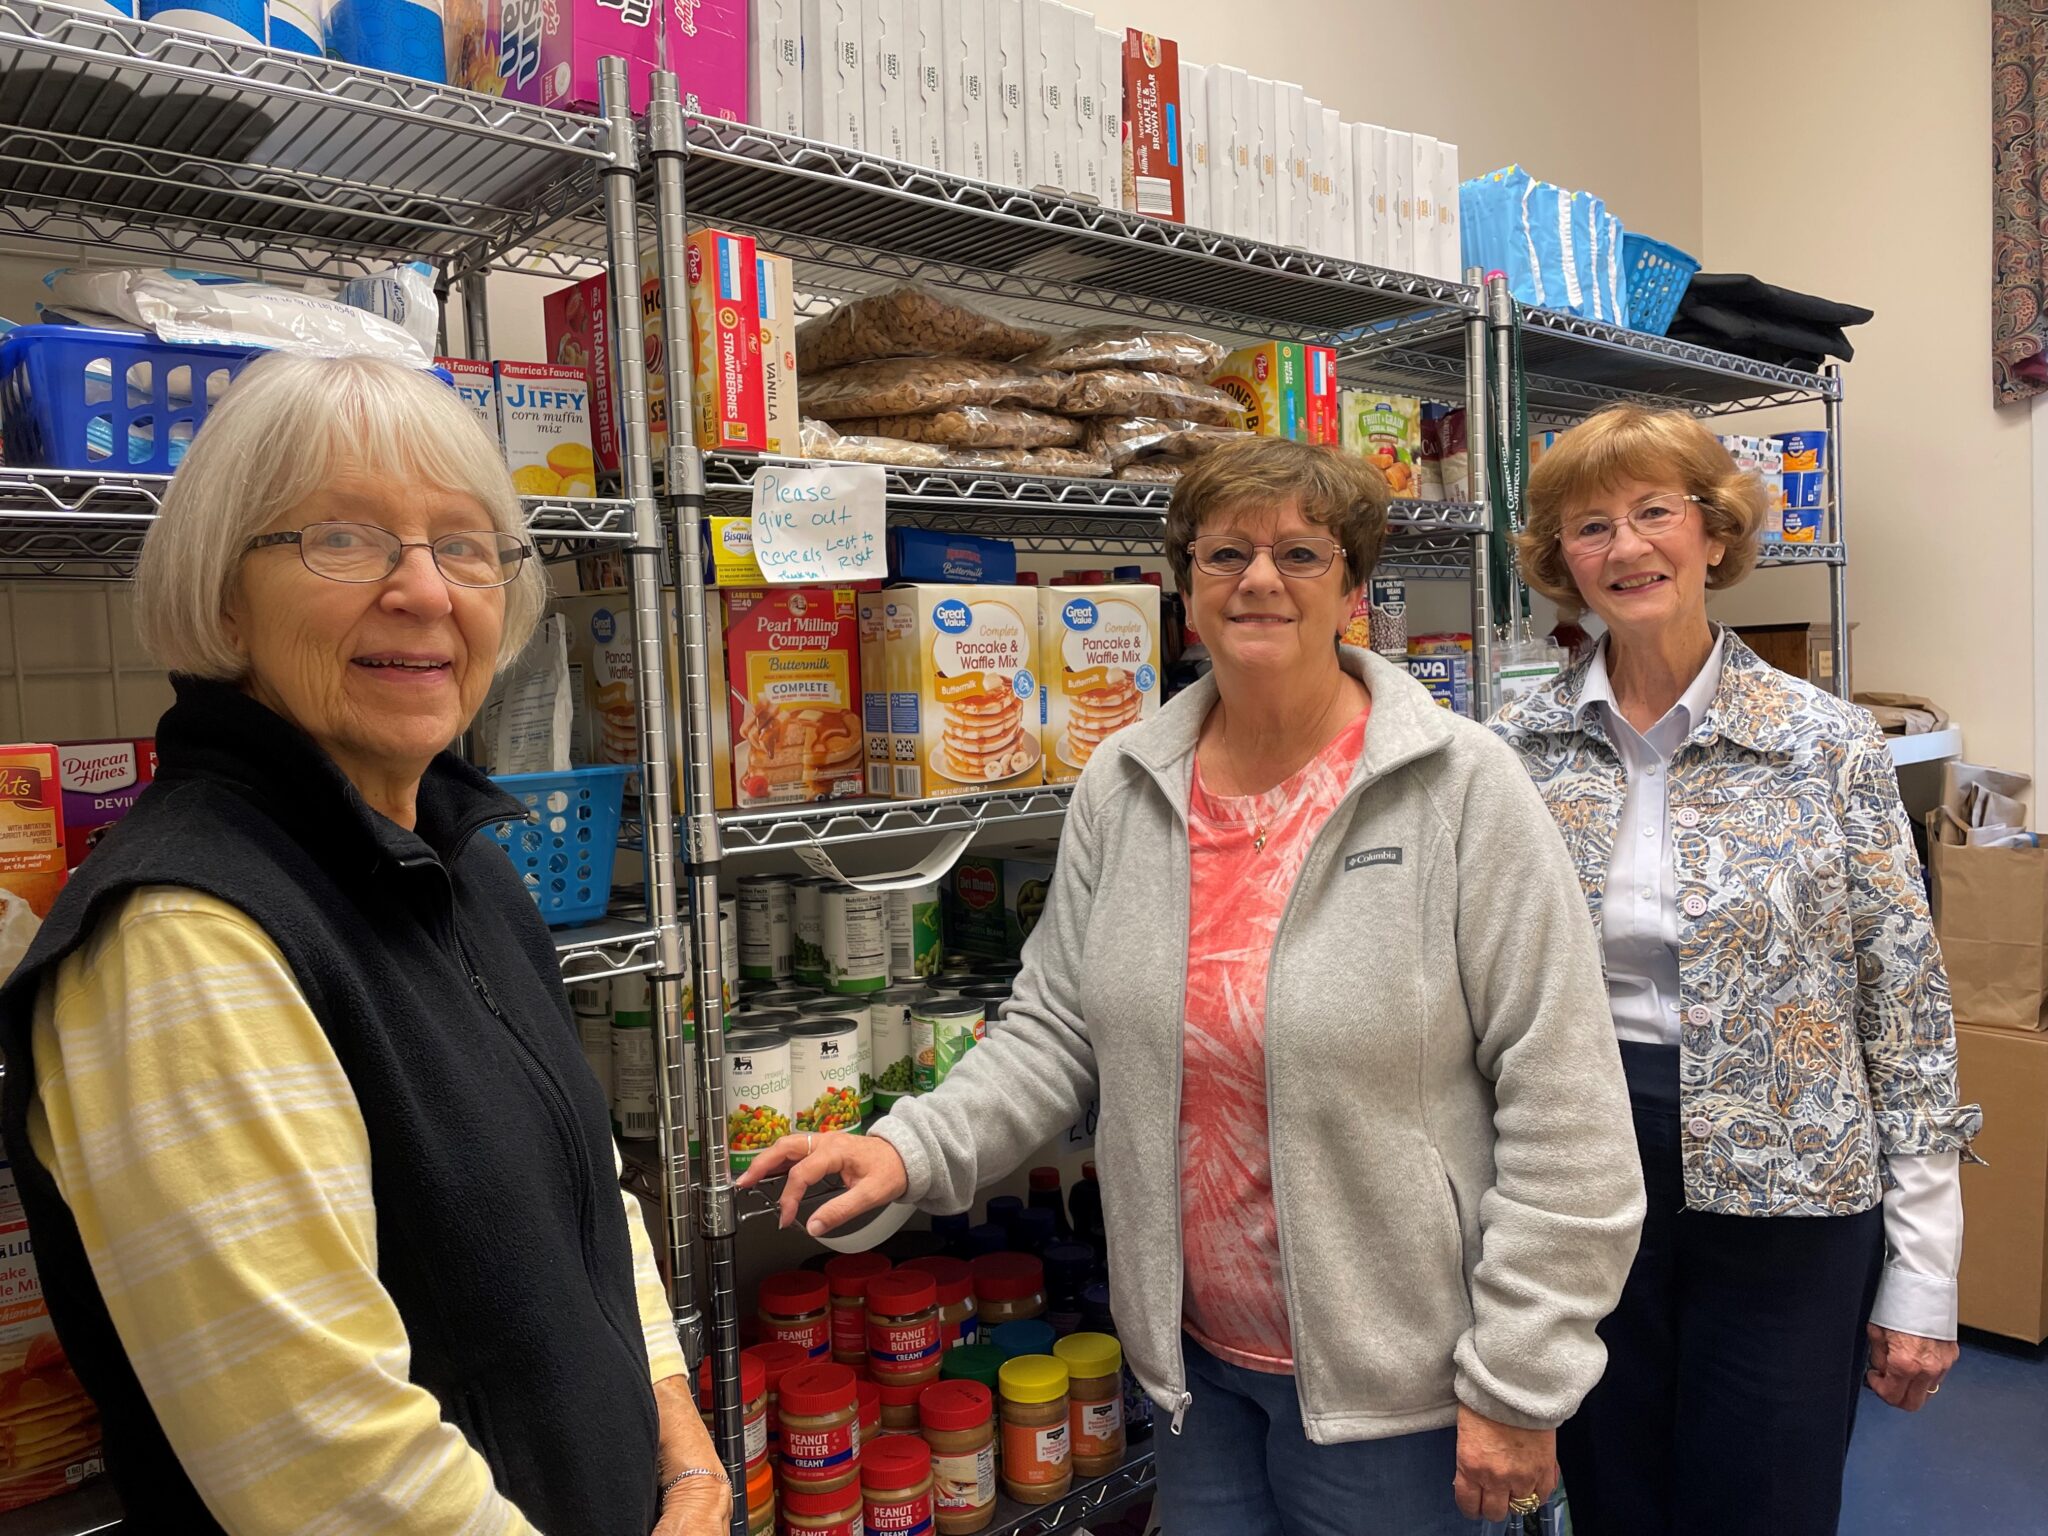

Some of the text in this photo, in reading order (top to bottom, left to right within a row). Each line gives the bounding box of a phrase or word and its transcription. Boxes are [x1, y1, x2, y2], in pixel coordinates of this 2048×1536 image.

[1143, 87, 1152, 133] MAPLE &
[1148, 74, 1160, 150] BROWN SUGAR
[1141, 145, 1149, 175] Millville
[687, 246, 701, 280] Post
[453, 361, 490, 375] Favorite
[503, 363, 584, 380] America's Favorite
[1256, 355, 1268, 378] Post
[592, 308, 613, 454] STRAWBERRIES
[723, 332, 738, 419] STRAWBERRIES
[506, 384, 586, 411] JIFFY
[766, 362, 778, 422] VANILLA
[511, 411, 584, 424] corn muffin
[1362, 413, 1380, 426] FRUIT
[1385, 413, 1405, 428] GRAIN
[537, 423, 562, 434] mix
[1500, 447, 1515, 509] Connection
[762, 474, 837, 505] Please
[758, 505, 852, 544] give out
[862, 531, 874, 544] to
[761, 547, 822, 566] cereals
[942, 561, 983, 578] Buttermilk
[1376, 581, 1394, 589] BLACK
[741, 600, 752, 608] 40
[936, 606, 966, 620] Great
[1066, 606, 1093, 618] Great
[757, 616, 840, 637] Pearl Milling
[943, 617, 966, 628] Value
[1072, 616, 1092, 625] Value
[979, 624, 1019, 637] Complete
[1104, 622, 1142, 636] Complete
[768, 633, 831, 651] Company
[955, 640, 1019, 655] Pancake &
[1082, 636, 1141, 651] Pancake &
[768, 657, 830, 672] Buttermilk
[960, 655, 1018, 670] Waffle Mix
[1086, 650, 1141, 665] Waffle Mix
[608, 666, 634, 680] Waffle
[1067, 673, 1100, 688] Buttermilk
[772, 682, 829, 695] COMPLETE
[941, 678, 977, 695] Buttermilk
[62, 753, 129, 775] Duncan
[73, 766, 126, 787] Hines
[7, 823, 51, 832] WITH IMITATION
[22, 829, 52, 838] FLAVORED
[23, 853, 52, 862] pudding
[1357, 850, 1397, 864] Columbia
[13, 862, 26, 870] the
[959, 875, 996, 893] Del Monte
[777, 1328, 814, 1340] PEANUT
[889, 1327, 926, 1342] PEANUT
[891, 1338, 927, 1352] BUTTER
[896, 1351, 923, 1362] CREAMY
[789, 1433, 829, 1446] PEANUT
[791, 1444, 829, 1457] BUTTER
[795, 1459, 825, 1468] CREAMY
[874, 1504, 913, 1518] PEANUT
[874, 1515, 913, 1528] BUTTER
